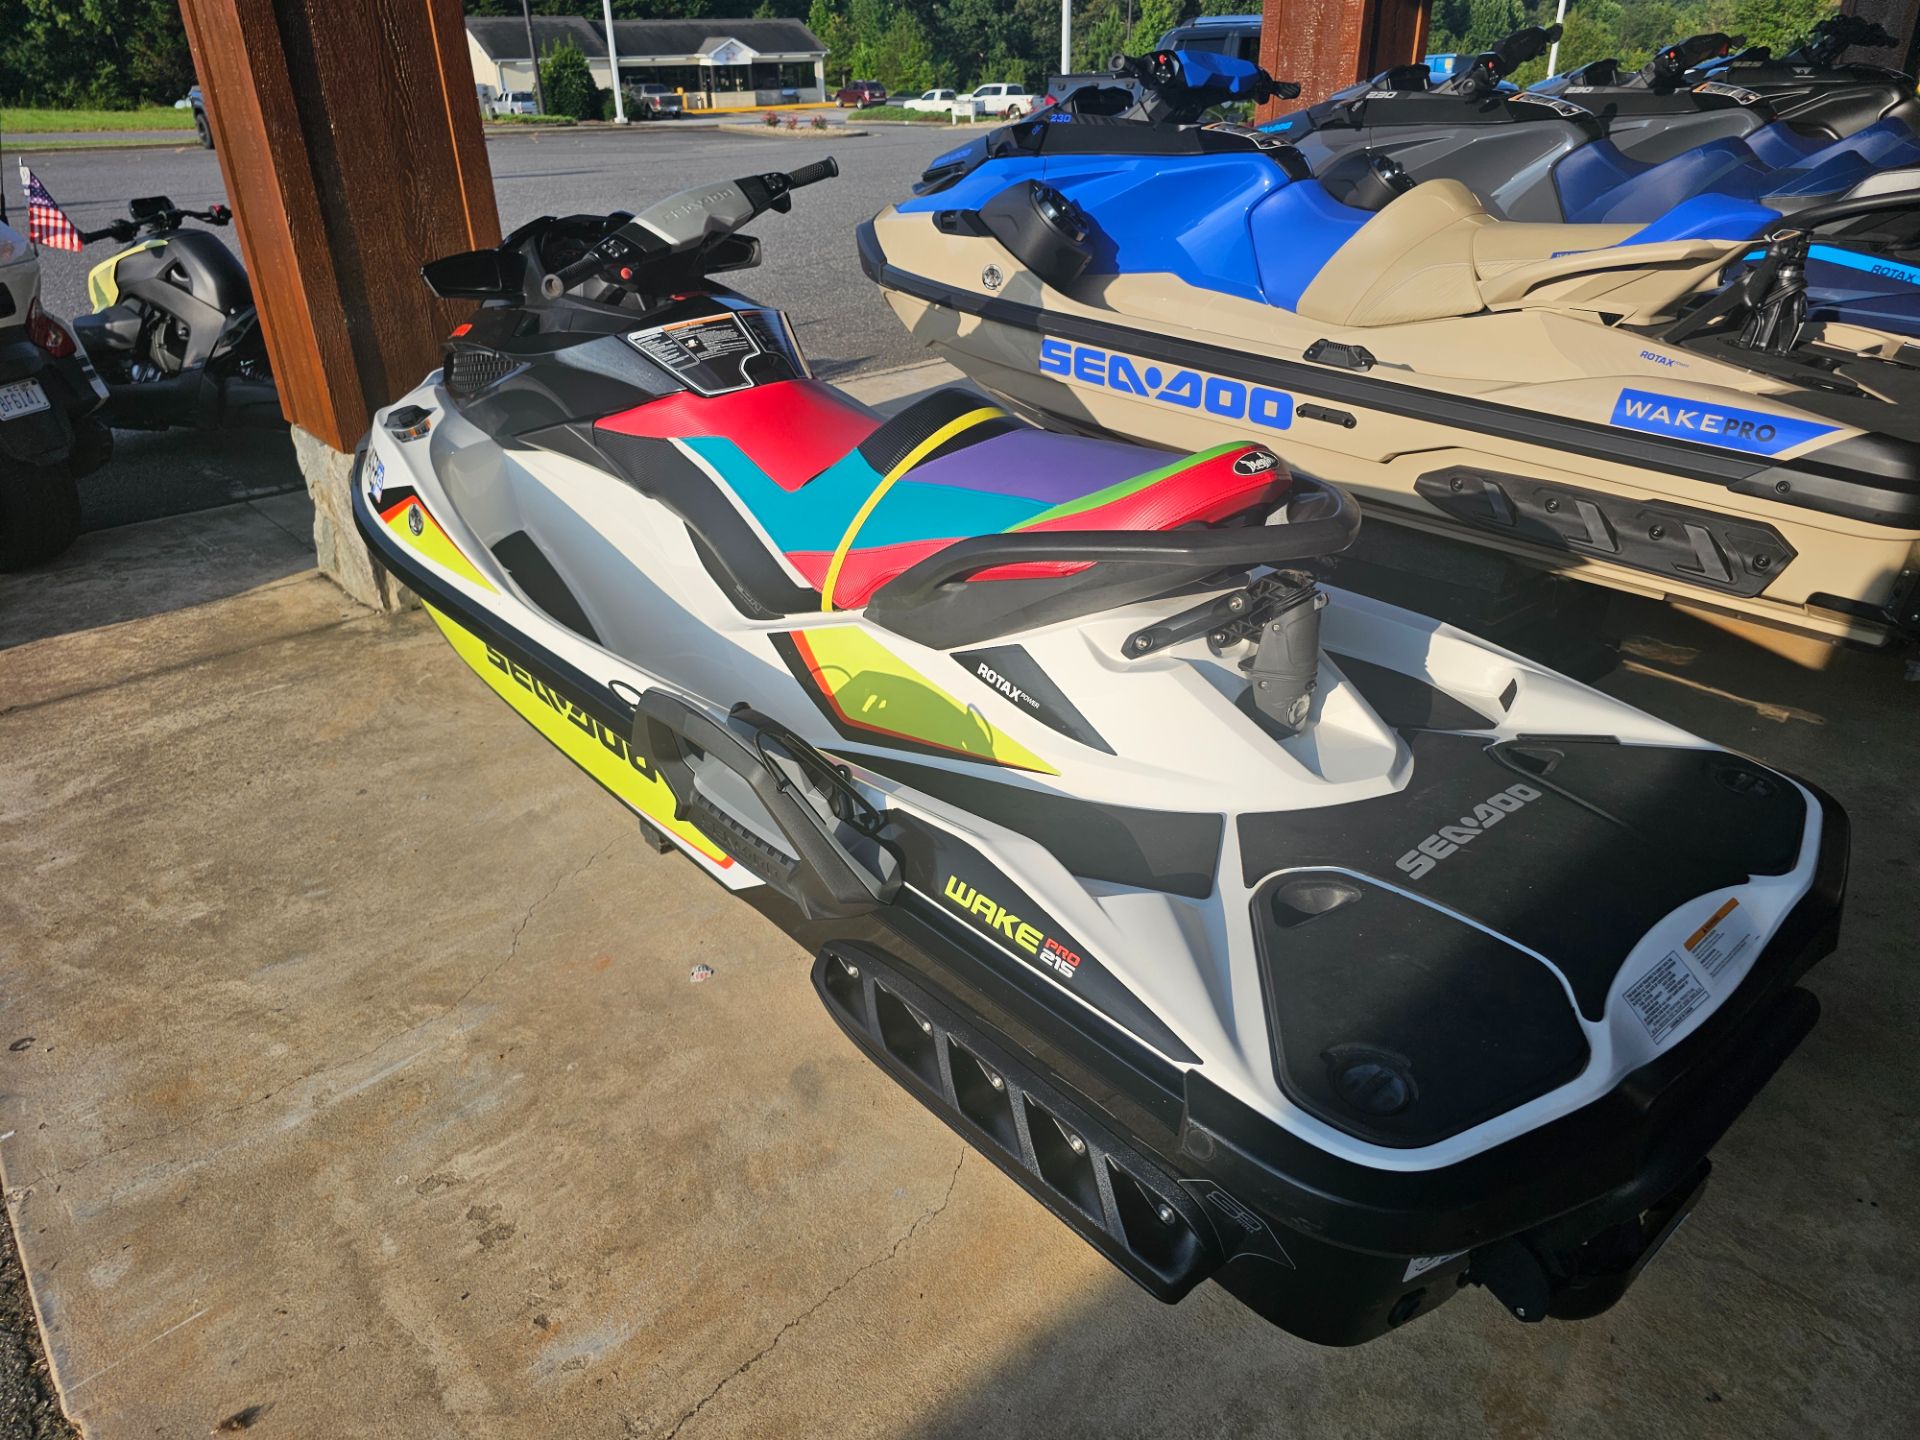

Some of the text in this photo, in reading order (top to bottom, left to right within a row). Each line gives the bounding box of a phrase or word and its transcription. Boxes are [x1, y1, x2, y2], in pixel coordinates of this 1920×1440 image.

[1366, 91, 1398, 99] 230
[1050, 113, 1073, 123] 230
[1871, 264, 1917, 284] ROTAX
[1640, 350, 1674, 368] ROTAX
[977, 662, 1040, 709] ROTAX POWER
[944, 875, 1082, 967] WAKE PRO
[1039, 948, 1076, 979] 215
